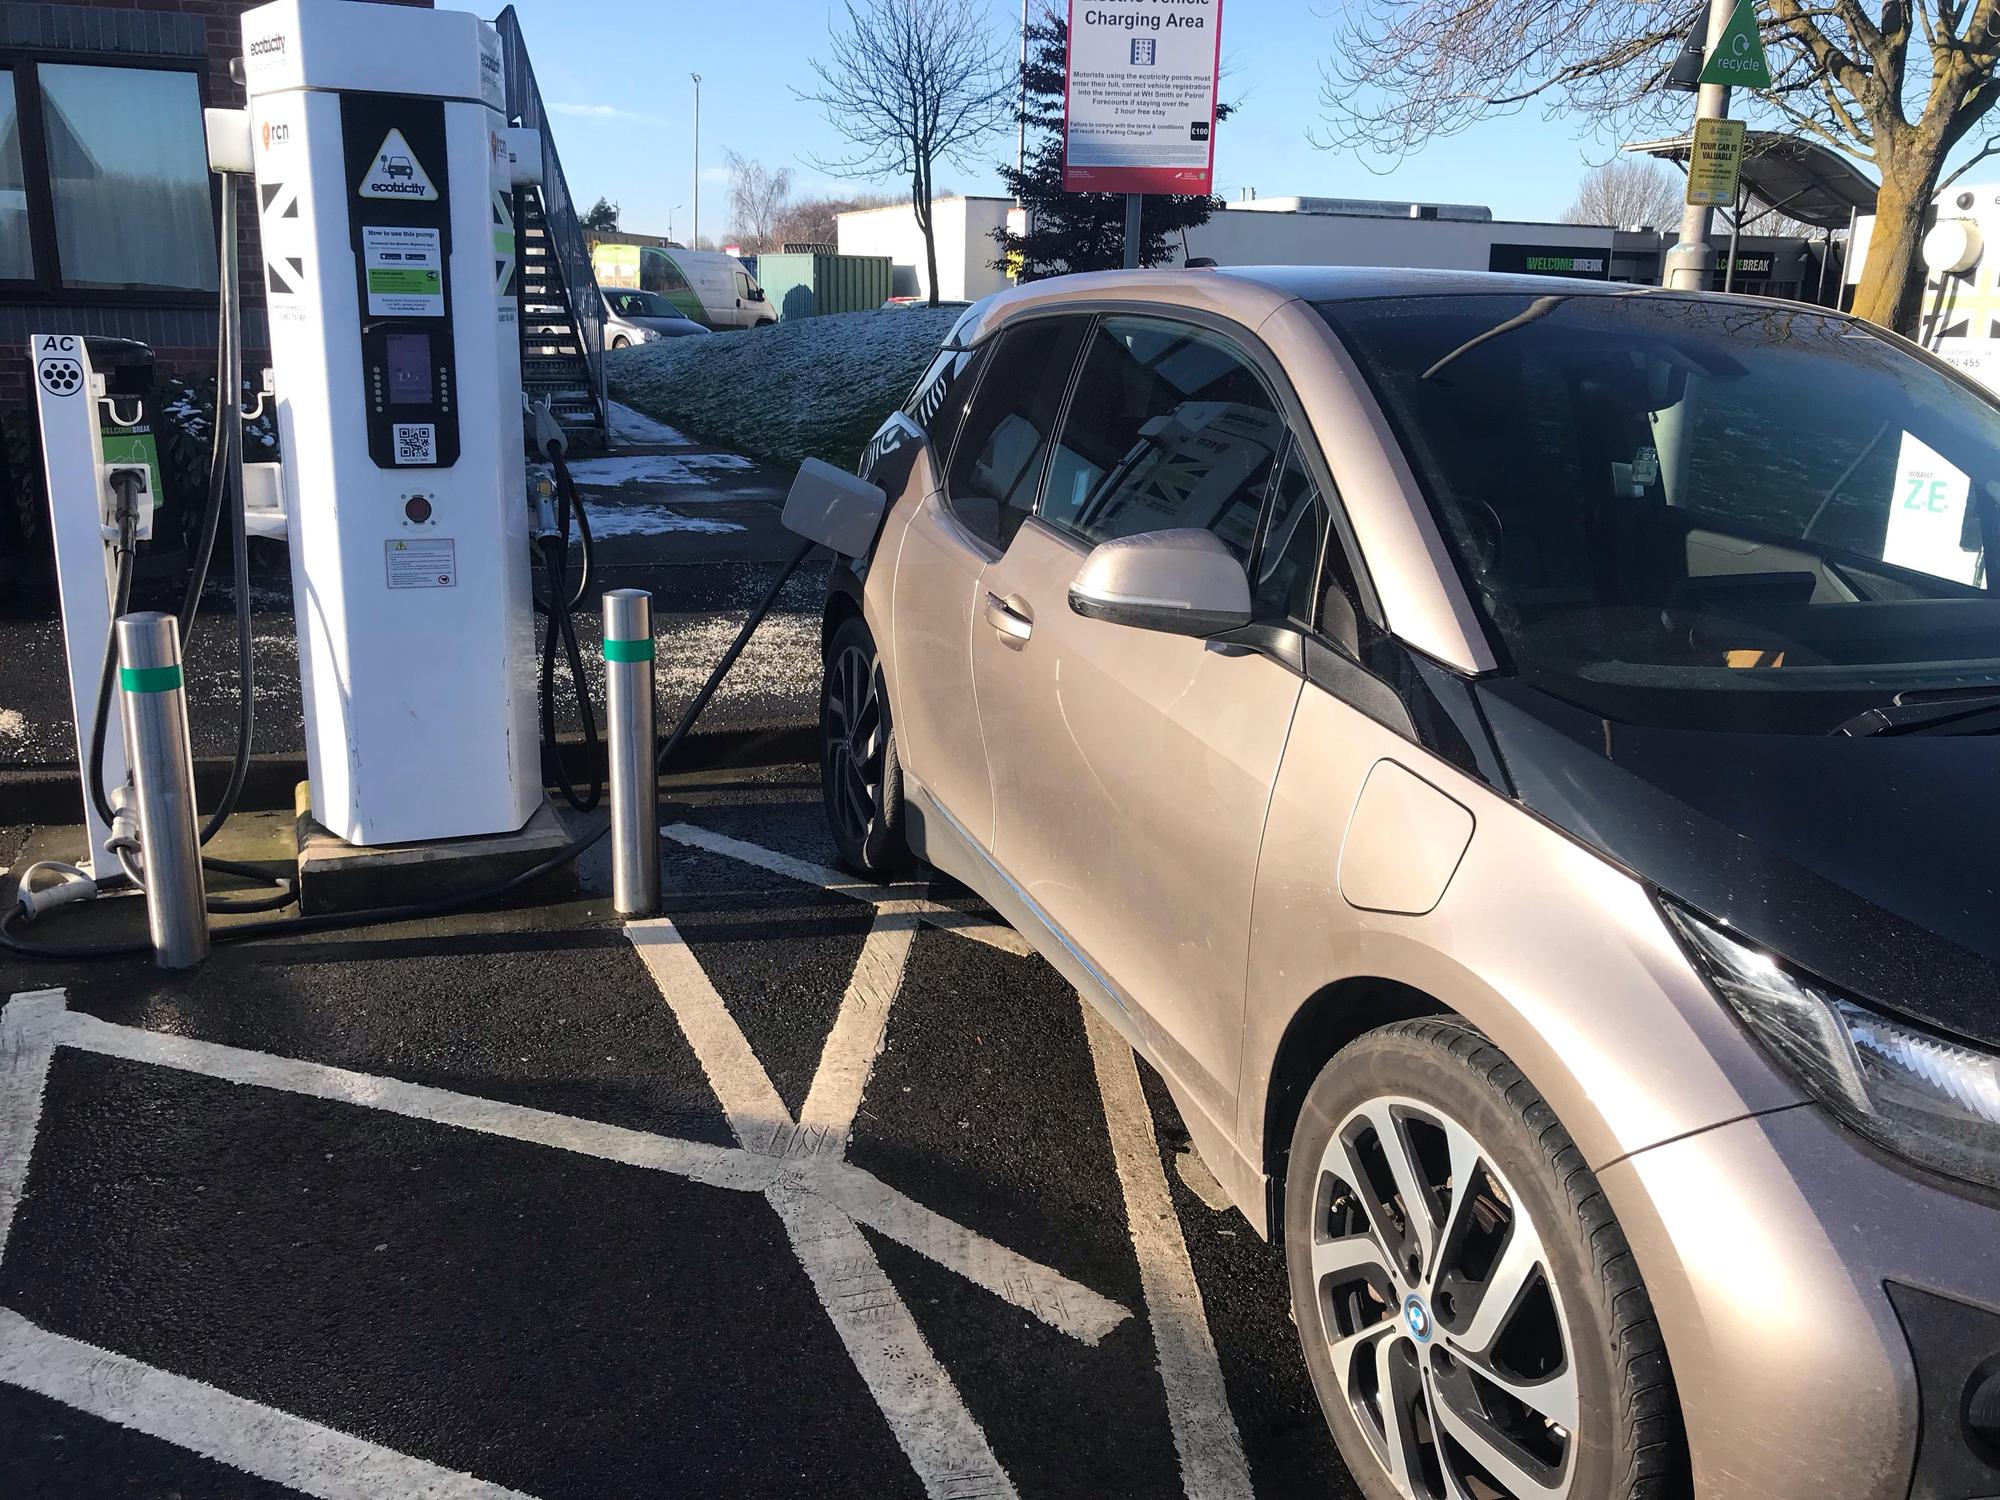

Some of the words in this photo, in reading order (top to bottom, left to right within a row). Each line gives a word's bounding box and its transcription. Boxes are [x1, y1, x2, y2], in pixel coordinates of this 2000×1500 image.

[1085, 10, 1160, 30] Charging
[1166, 13, 1204, 28] Area
[250, 34, 286, 56] ecotricity
[1718, 57, 1760, 72] recycle
[271, 124, 289, 140] rcn
[1700, 142, 1716, 150] YOUR
[1702, 152, 1733, 160] VALUABLE
[371, 182, 426, 196] ecotricity
[1526, 256, 1603, 272] WELCOMEBREAK
[42, 336, 74, 351] AC
[1963, 358, 1980, 368] 455
